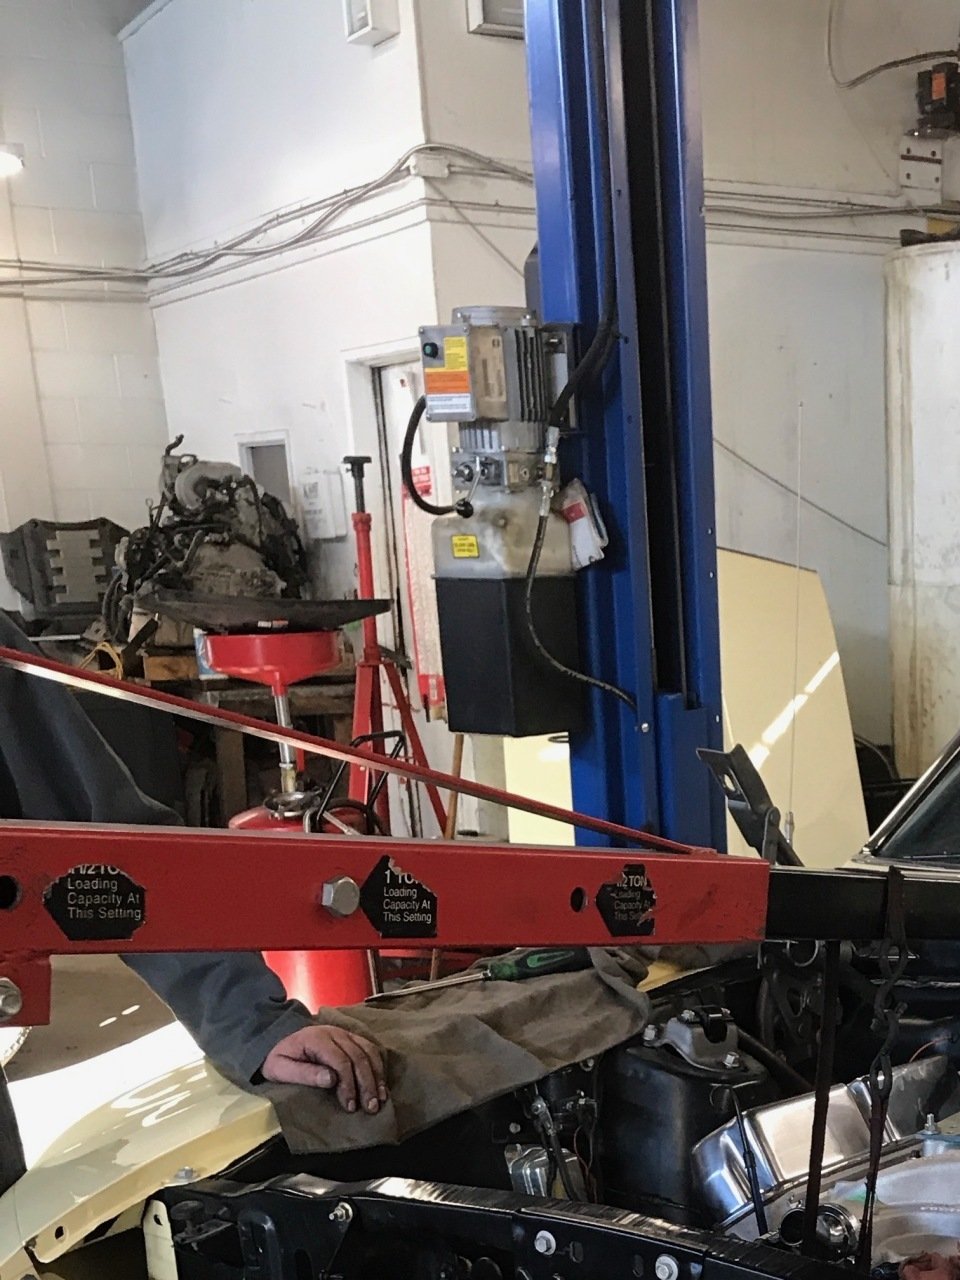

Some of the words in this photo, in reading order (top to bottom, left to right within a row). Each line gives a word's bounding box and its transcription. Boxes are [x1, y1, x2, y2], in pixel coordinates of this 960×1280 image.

[384, 869, 391, 884] 1
[398, 873, 419, 885] TO
[628, 875, 648, 887] TON
[67, 878, 118, 892] Loading
[67, 892, 123, 907] Capacity
[127, 892, 140, 904] At
[383, 886, 418, 900] Loading
[383, 898, 420, 911] Capacity
[421, 899, 431, 910] At
[67, 907, 94, 919] This
[98, 907, 141, 921] Setting
[383, 911, 402, 922] This
[403, 911, 432, 924] Setting
